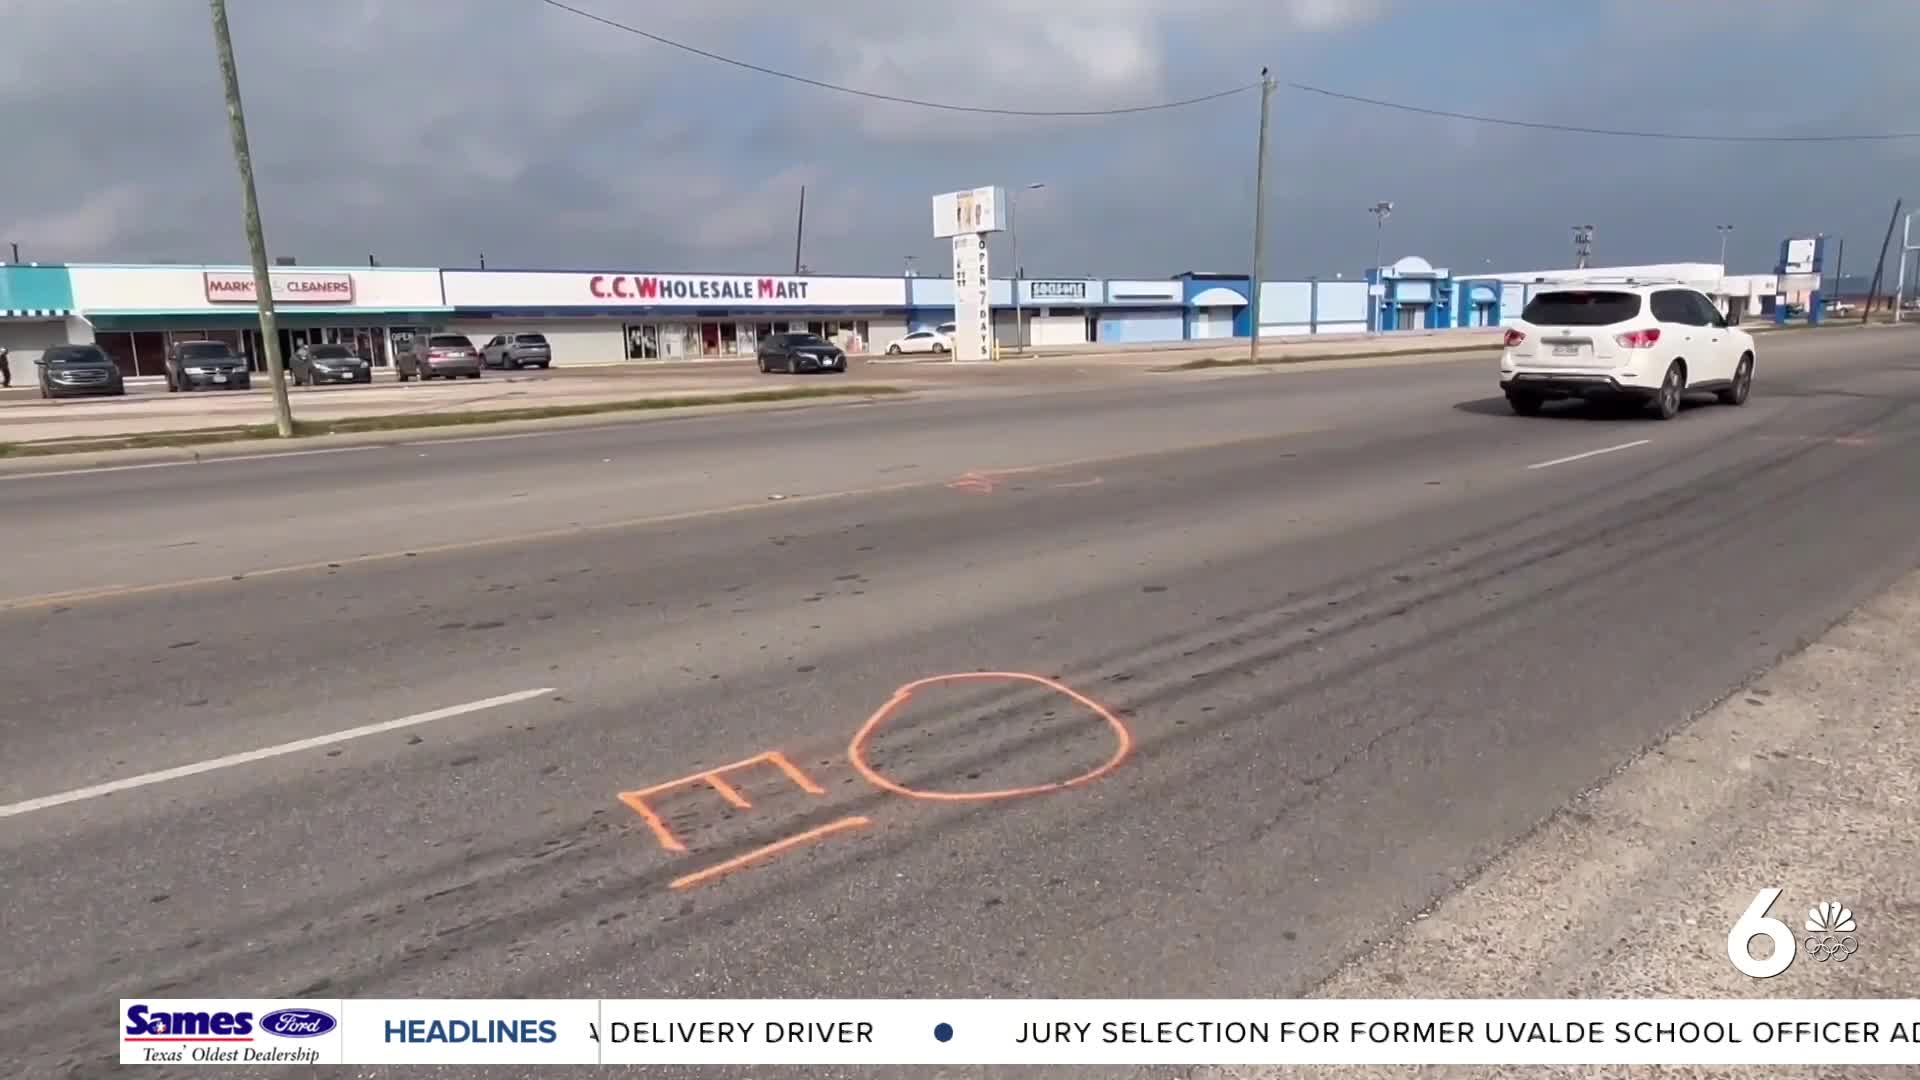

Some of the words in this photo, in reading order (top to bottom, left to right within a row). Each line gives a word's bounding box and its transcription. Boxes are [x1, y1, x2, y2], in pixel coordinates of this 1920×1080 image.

[209, 280, 257, 292] MARK'
[287, 281, 349, 293] CLEANERS
[757, 279, 808, 299] MART
